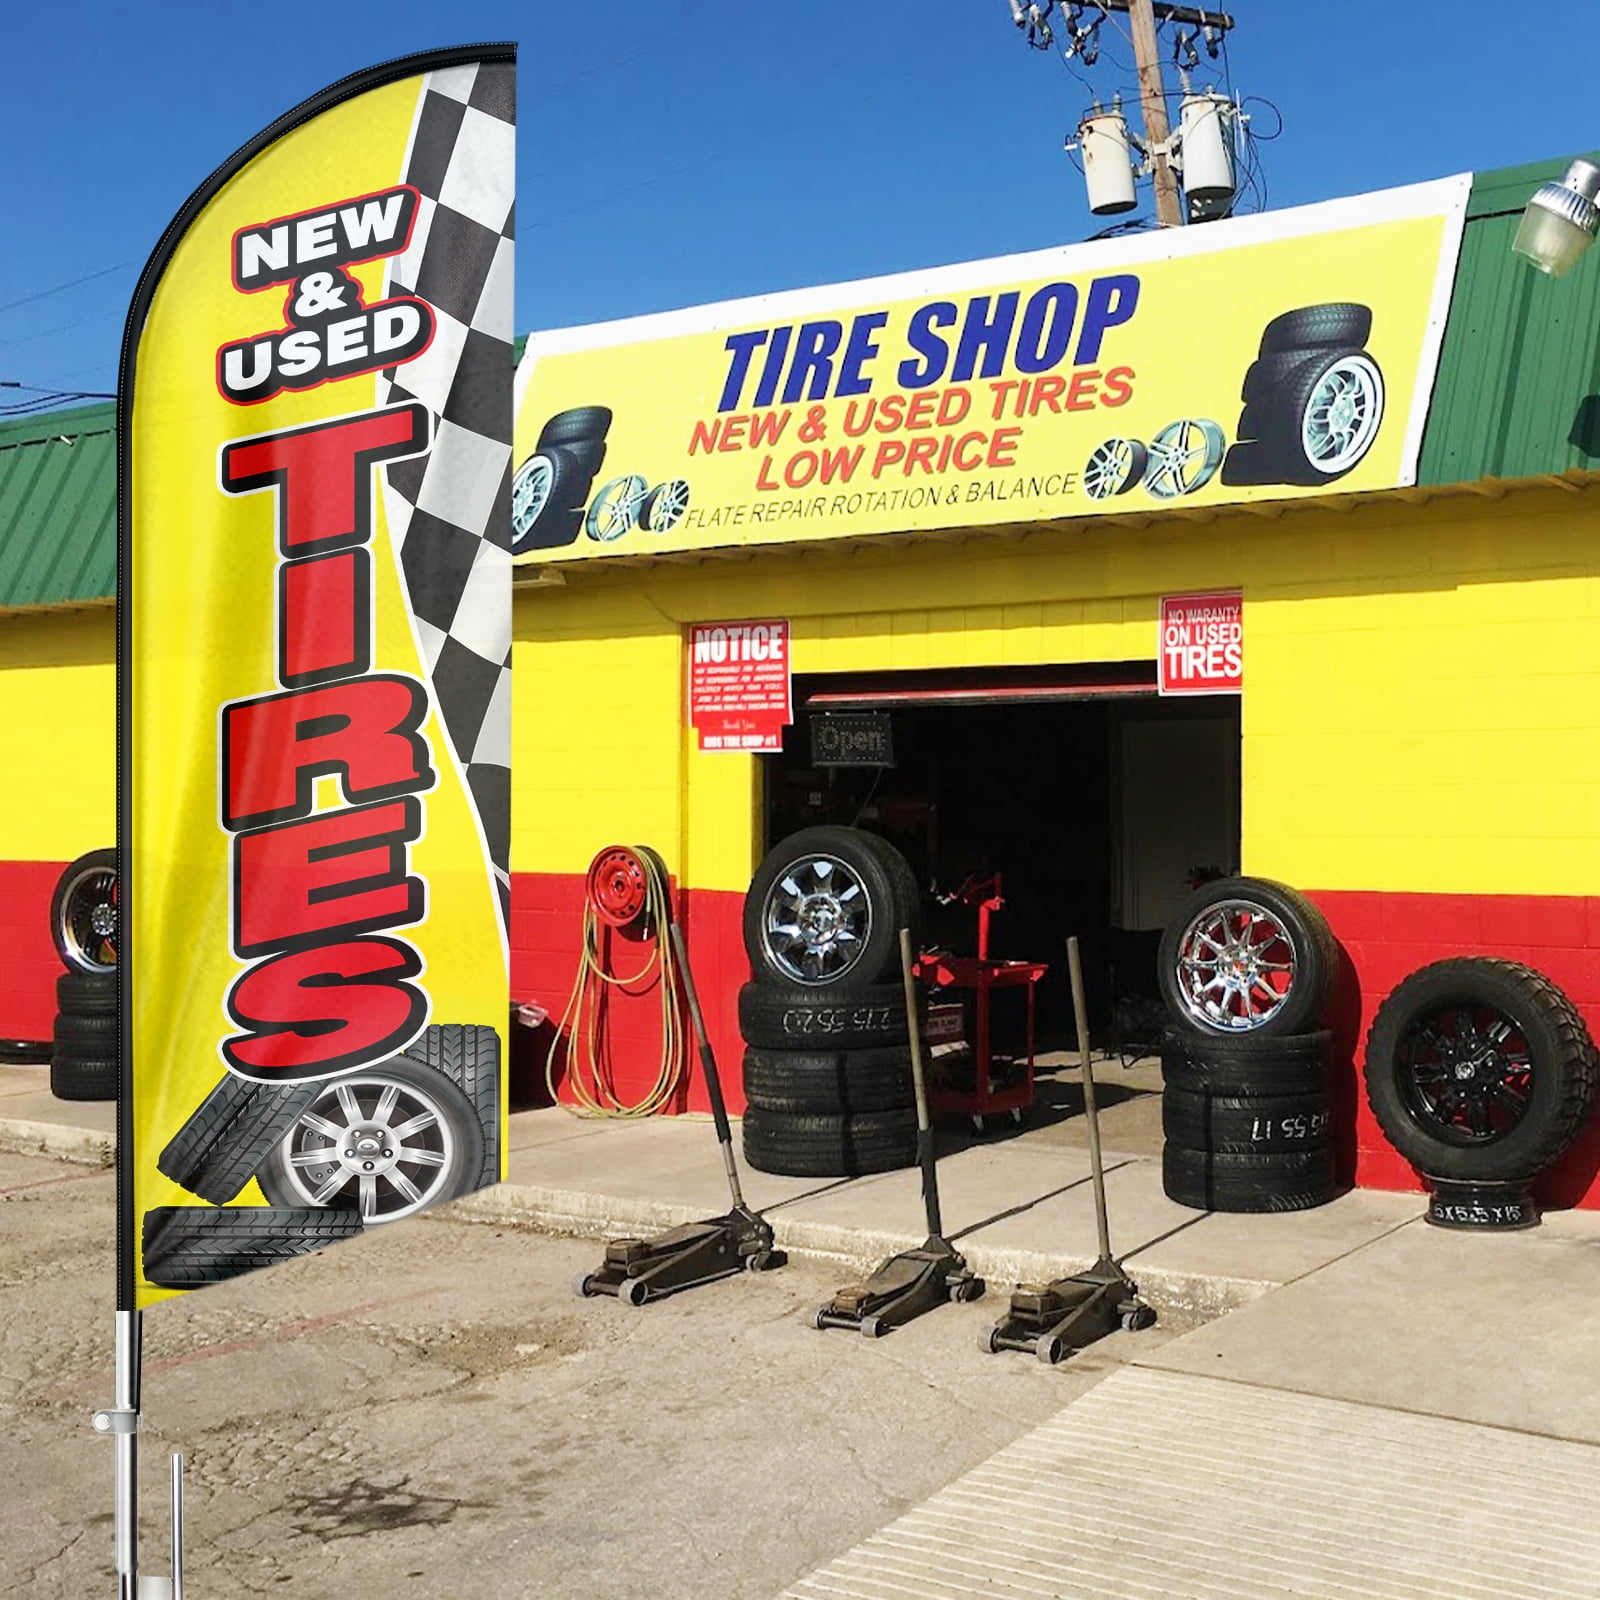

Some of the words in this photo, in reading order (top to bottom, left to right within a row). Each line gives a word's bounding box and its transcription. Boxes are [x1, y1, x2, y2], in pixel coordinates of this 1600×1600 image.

[241, 193, 405, 279] NEW
[294, 271, 348, 318] &
[224, 304, 422, 392] USED
[716, 310, 890, 413] TIRE
[896, 273, 1142, 390] SHOP
[687, 410, 793, 457] NEW
[797, 403, 828, 442] &
[841, 385, 972, 439] USED
[988, 365, 1137, 421] TIRES
[754, 443, 865, 492] LOW
[870, 427, 1024, 480] PRICE
[684, 504, 748, 530] FLATE
[749, 495, 827, 524] REPAIR
[830, 486, 941, 517] ROTATION
[945, 484, 961, 505] &
[965, 472, 1080, 503] BALANCE
[694, 624, 784, 664] NOTICE
[1165, 625, 1191, 646] ON
[1195, 622, 1242, 645] USED
[1168, 609, 1184, 625] NO
[1186, 606, 1240, 624] WARANTY
[1164, 643, 1242, 680] TIRES
[224, 407, 432, 1074] TIRES
